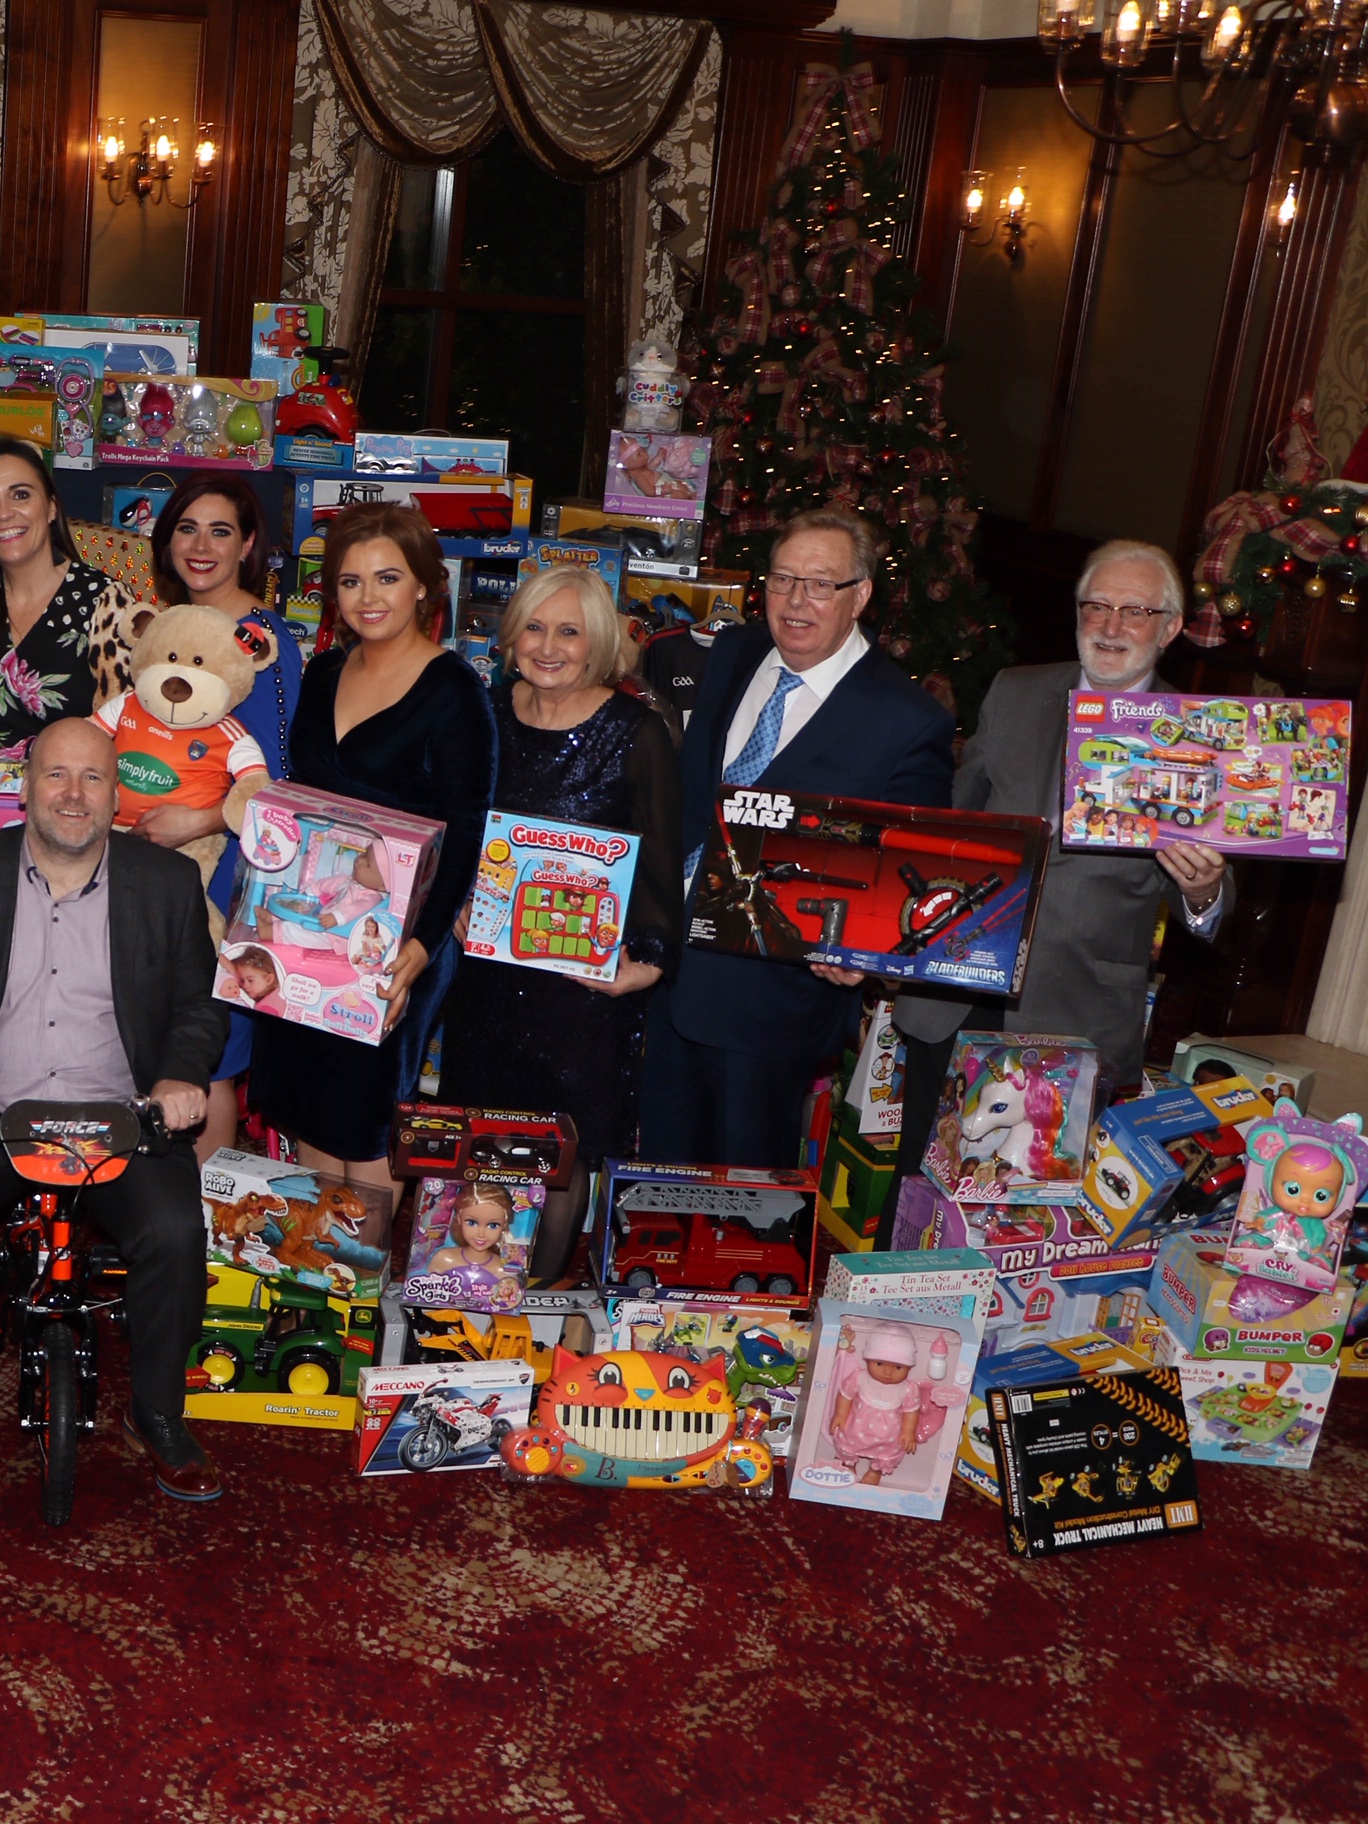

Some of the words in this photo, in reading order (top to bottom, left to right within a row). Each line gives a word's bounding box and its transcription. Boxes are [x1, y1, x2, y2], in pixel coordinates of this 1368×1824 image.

[635, 382, 678, 395] Cuddly
[628, 393, 681, 406] Critters
[102, 452, 116, 460] Trolls
[117, 454, 131, 462] Mega
[483, 542, 521, 554] bruder
[1077, 704, 1103, 715] LEGO
[1111, 699, 1163, 722] Friends
[723, 790, 795, 813] STAR
[723, 805, 793, 829] WARS
[511, 825, 567, 848] Guess
[568, 833, 628, 863] Who?
[924, 961, 1006, 986] BLADEBUILDERS
[330, 1003, 375, 1026] Stroll
[484, 1113, 529, 1122] RACING
[532, 1116, 556, 1124] CAR
[39, 1120, 99, 1134] FORCE
[618, 1165, 653, 1173] FIRE
[655, 1167, 712, 1177] ENGINE
[205, 1171, 235, 1186] ROBO
[479, 1174, 519, 1183] RACING
[520, 1176, 542, 1185] CAR
[204, 1182, 233, 1195] ALIVE
[951, 1177, 1005, 1200] Barbie
[1042, 1237, 1108, 1264] Dream
[1265, 1259, 1293, 1272] CRY
[901, 1275, 916, 1283] Tin
[918, 1275, 934, 1283] Tea
[937, 1274, 951, 1283] Set
[407, 1277, 462, 1296] Sparkle
[882, 1285, 898, 1293] Tee
[900, 1284, 914, 1293] Set
[933, 1281, 962, 1291] Metall
[666, 1292, 695, 1300] FIRE
[697, 1293, 741, 1303] ENGINE
[631, 1312, 664, 1325] HEROES
[371, 1381, 425, 1392] MECCANO
[265, 1404, 301, 1414] Roarin'
[304, 1407, 339, 1417] Tractor
[805, 1469, 851, 1483] DOTTIE
[957, 1459, 999, 1496] bruder
[1082, 1521, 1135, 1541] MECHANICAL
[1137, 1517, 1163, 1532] HEAVY
[1053, 1529, 1082, 1546] TRUCK
